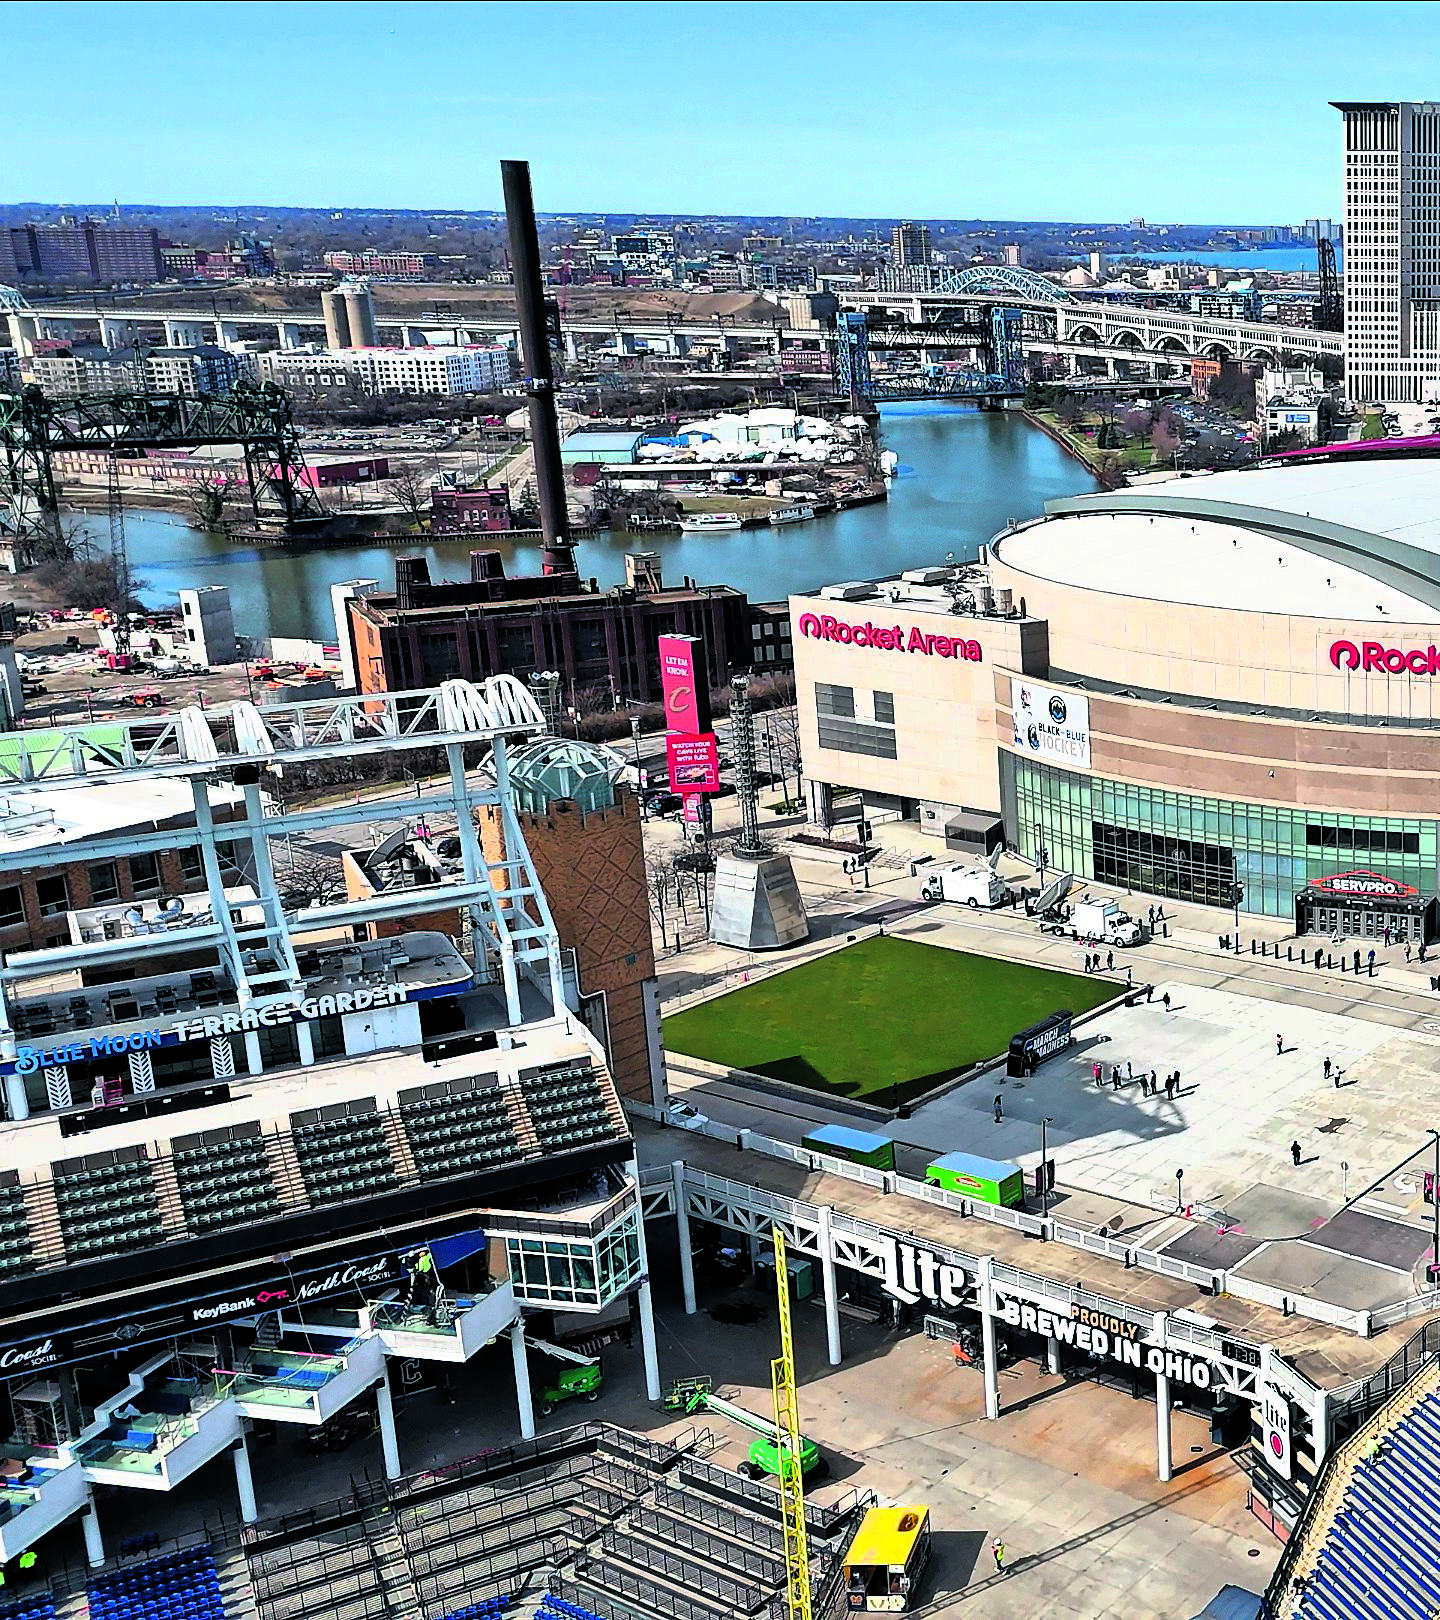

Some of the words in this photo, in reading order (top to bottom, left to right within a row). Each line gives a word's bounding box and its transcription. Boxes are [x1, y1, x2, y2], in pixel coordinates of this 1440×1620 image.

[820, 615, 905, 652] Rocket
[908, 627, 982, 662] Arena
[1038, 722, 1060, 736] BLACK
[1066, 729, 1086, 742] BLUE
[1039, 732, 1085, 758] HOCKEY
[1332, 879, 1396, 894] SERVPRO
[172, 1002, 292, 1043] TERRACE
[299, 982, 407, 1019] GARDEN
[1032, 1027, 1058, 1050] MARCH
[1036, 1032, 1069, 1058] MADNESS
[289, 1271, 343, 1302] North
[342, 1258, 387, 1283] Coast
[193, 1298, 255, 1320] KeyBank
[1070, 1304, 1140, 1339] PROUDLY
[0, 1339, 53, 1368] Coast
[1003, 1303, 1109, 1356] BREWED
[1113, 1334, 1142, 1367] IN
[1147, 1348, 1211, 1390] OHIO
